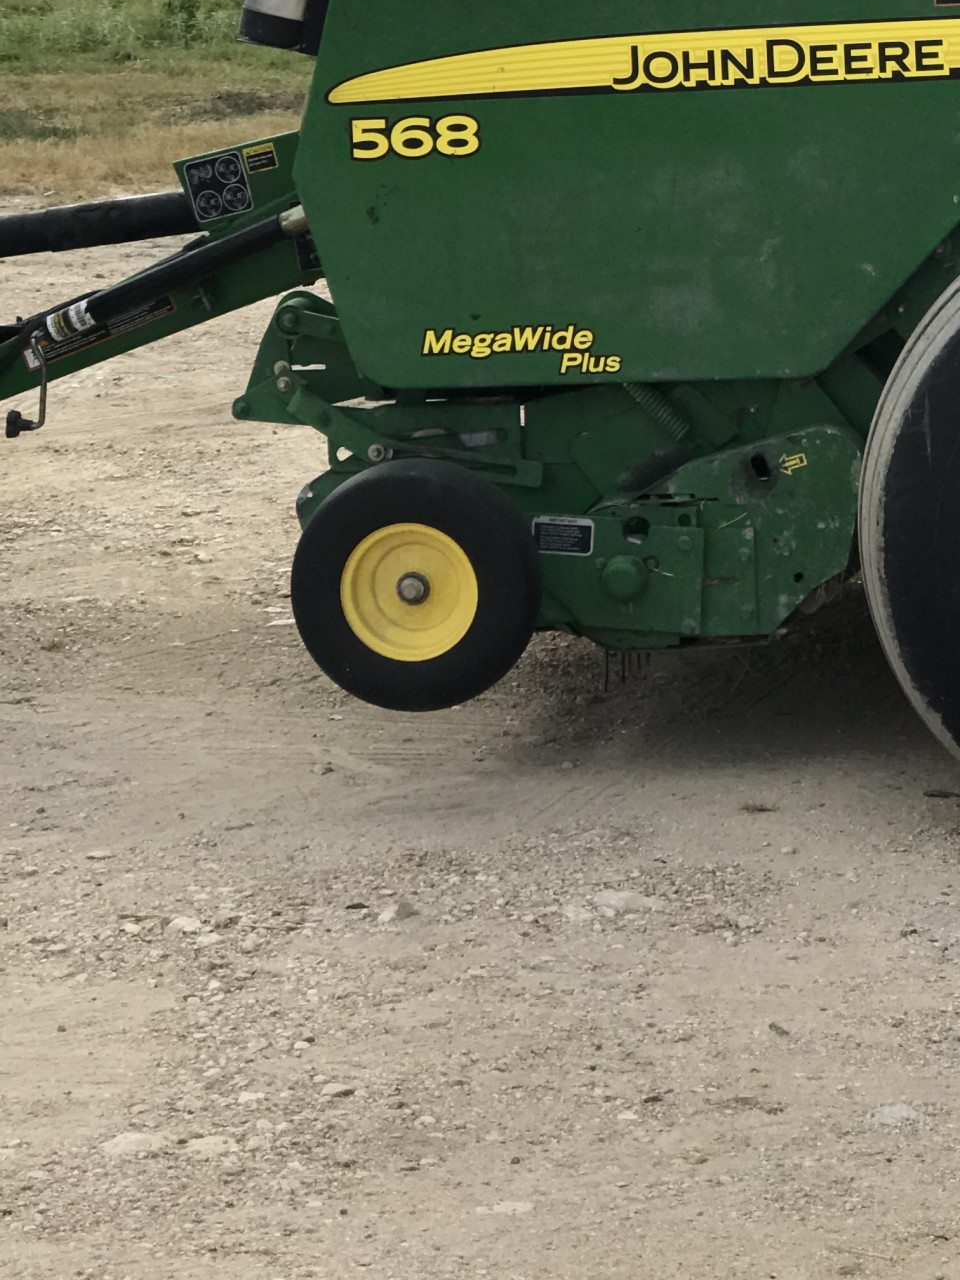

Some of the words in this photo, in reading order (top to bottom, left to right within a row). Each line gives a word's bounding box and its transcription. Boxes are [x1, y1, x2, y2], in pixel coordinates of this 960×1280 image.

[611, 43, 756, 88] JOHN
[765, 38, 947, 80] DEERE
[351, 114, 480, 160] 568
[421, 324, 595, 359] MegaWide
[560, 352, 622, 374] Plus
